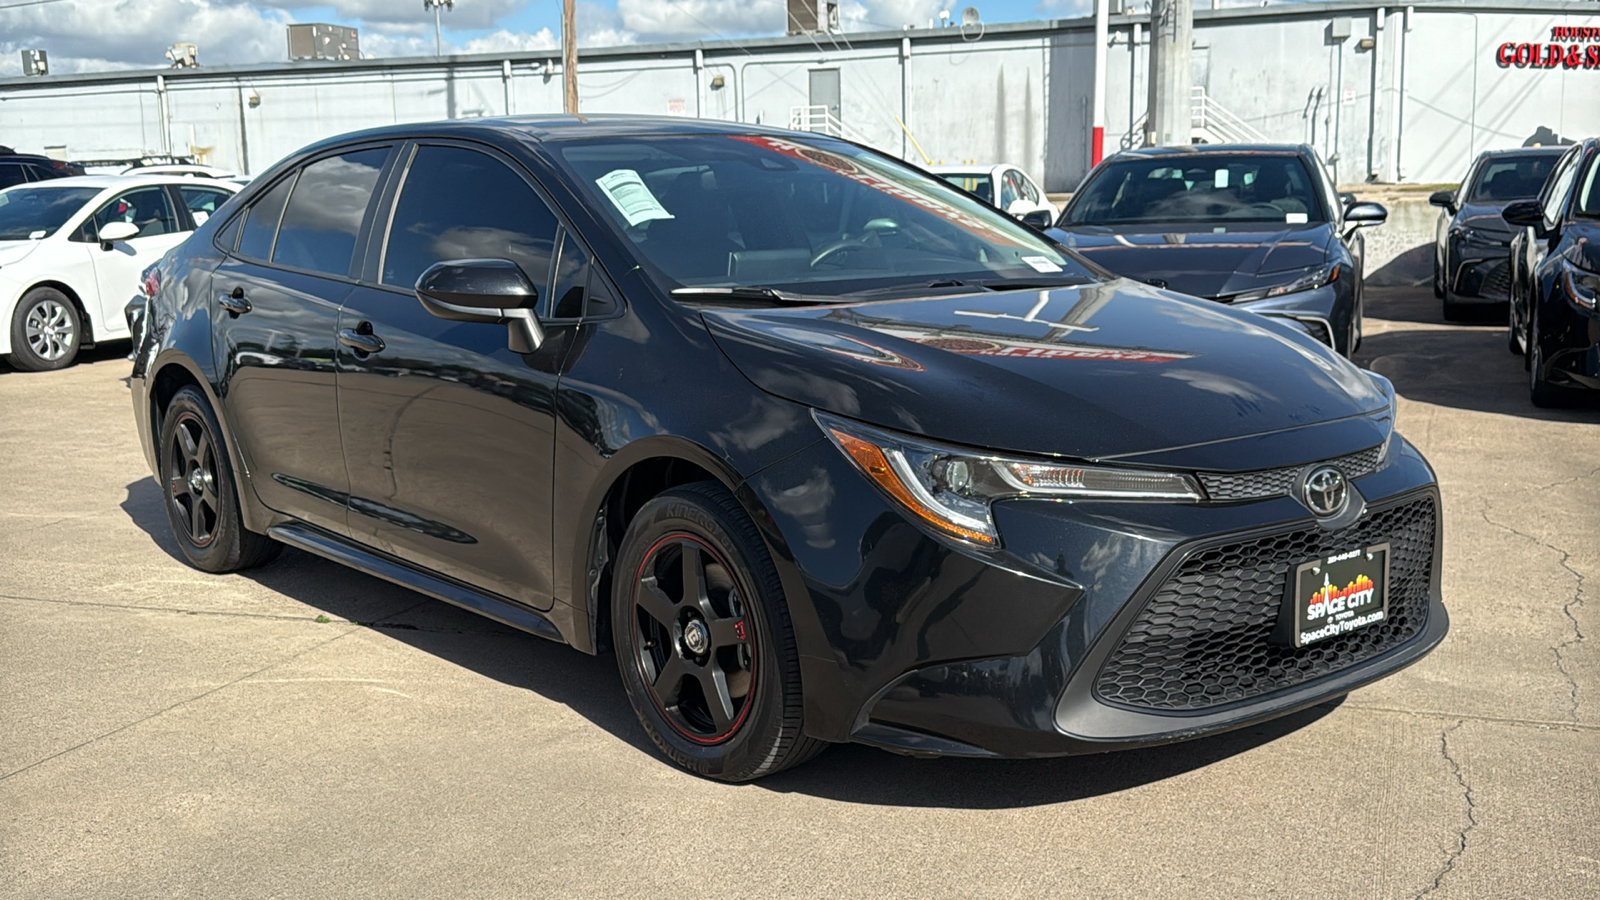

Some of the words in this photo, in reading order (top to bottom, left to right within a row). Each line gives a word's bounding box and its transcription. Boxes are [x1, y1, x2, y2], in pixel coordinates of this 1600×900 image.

[1553, 26, 1600, 39] HOUST
[1499, 42, 1564, 66] GOLD
[1566, 44, 1584, 67] &
[1307, 596, 1346, 620] SPACE
[1347, 588, 1374, 609] CITY
[1335, 610, 1355, 620] TOYOTA
[1300, 611, 1384, 644] SpaceCityToyota.com
